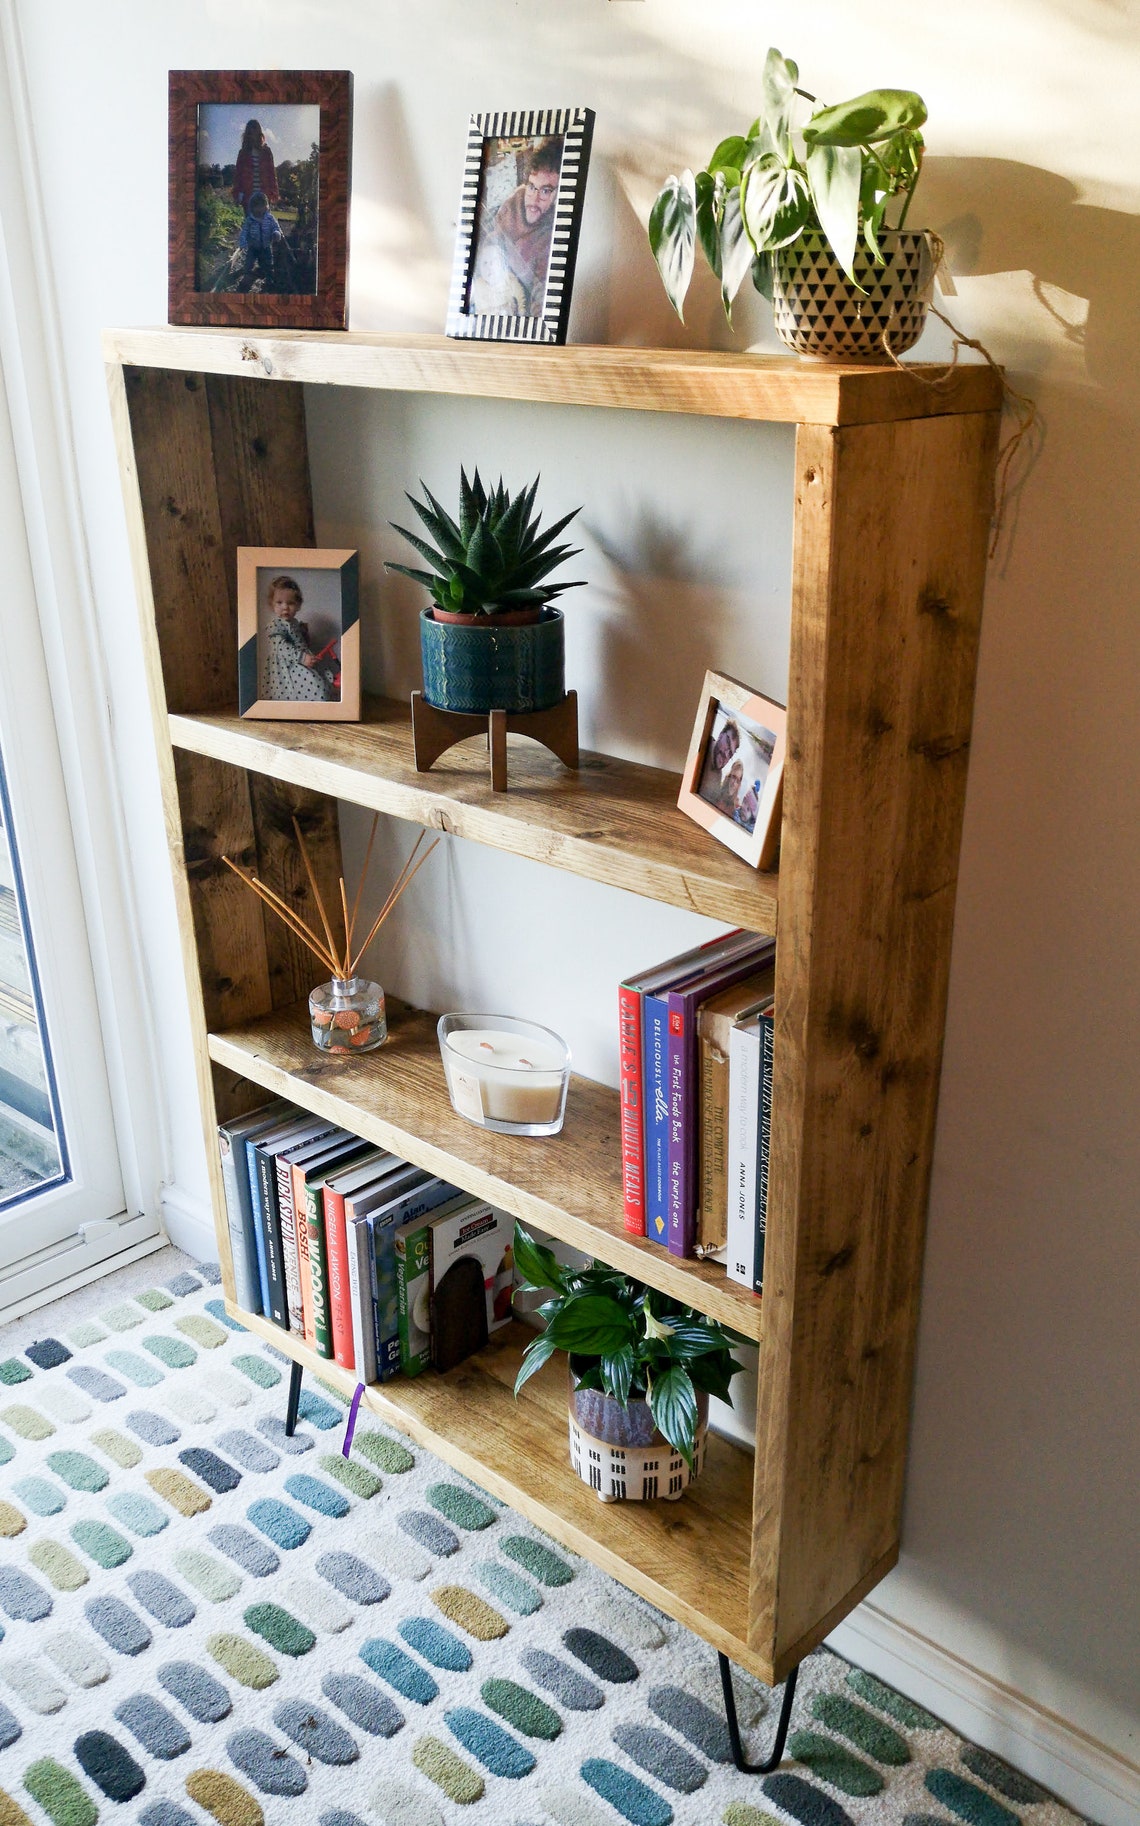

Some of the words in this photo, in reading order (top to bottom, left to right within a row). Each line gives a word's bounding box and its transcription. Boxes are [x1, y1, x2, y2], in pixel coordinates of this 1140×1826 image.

[620, 997, 638, 1074] JAMIE'S
[653, 1018, 662, 1085] DELICIOUSLY
[763, 1024, 775, 1062] DELIA
[672, 1067, 682, 1090] First
[671, 1091, 683, 1118] Foods
[623, 1107, 640, 1160] MINUTE
[672, 1119, 682, 1143] Book
[261, 1165, 269, 1195] modern
[276, 1165, 291, 1204] RICK
[624, 1161, 641, 1207] MEALS
[672, 1161, 682, 1176] the
[402, 1203, 426, 1221] Alan
[671, 1178, 682, 1209] purple
[738, 1190, 746, 1221] JONES
[279, 1201, 295, 1245] STEIN
[298, 1208, 310, 1263] BOSH!
[326, 1198, 338, 1246] NIGELLA
[672, 1212, 680, 1229] one
[310, 1258, 326, 1324] COOK
[329, 1248, 342, 1301] LAWSON
[396, 1262, 407, 1316] Vegetarian
[336, 1302, 345, 1336] FEAST
